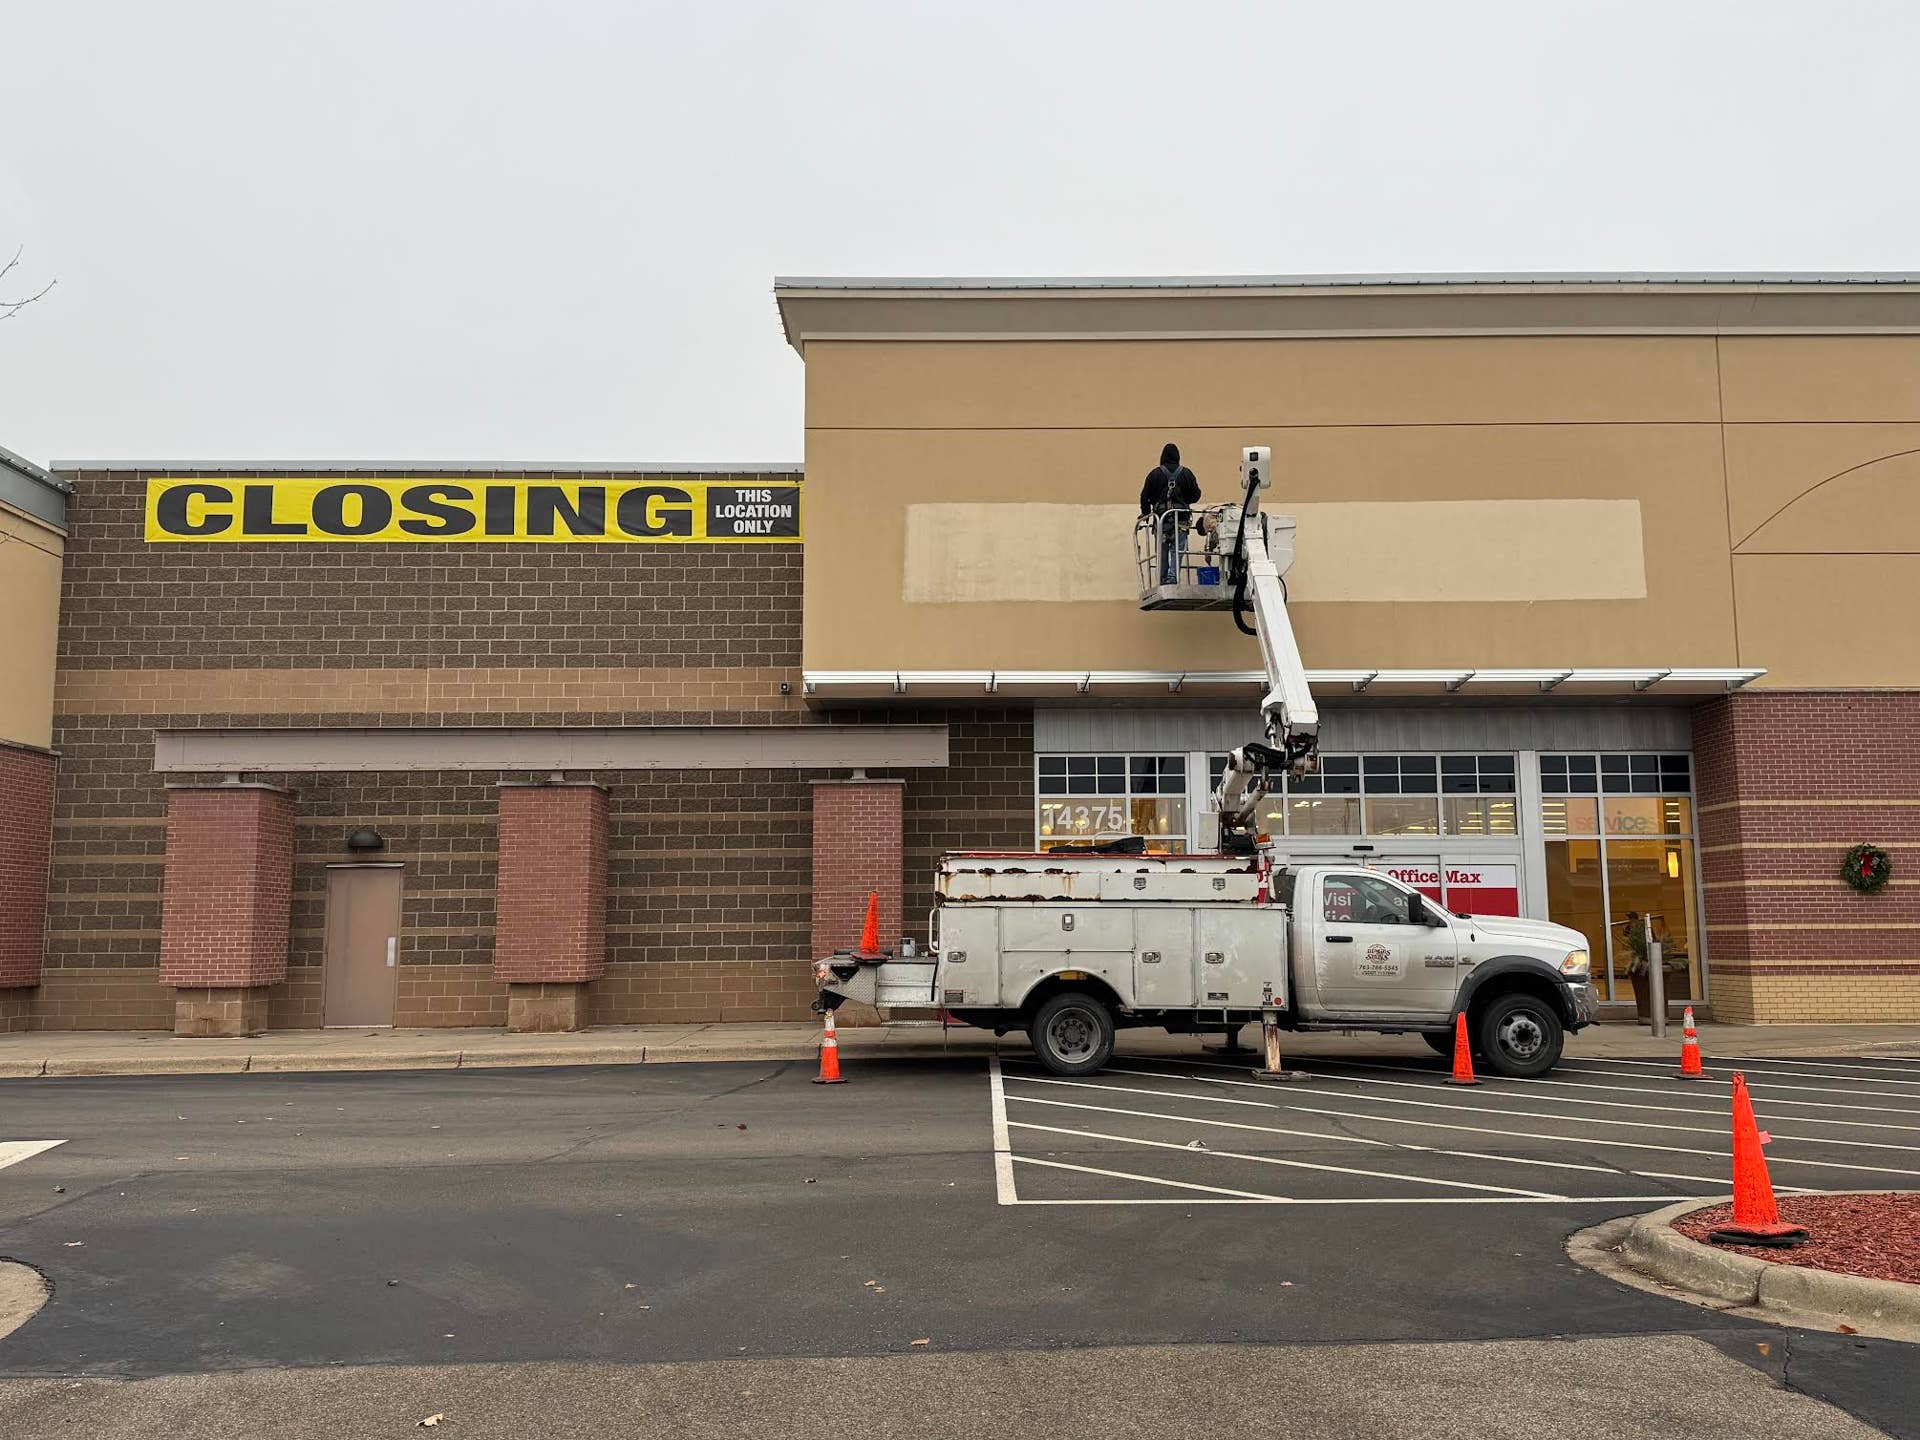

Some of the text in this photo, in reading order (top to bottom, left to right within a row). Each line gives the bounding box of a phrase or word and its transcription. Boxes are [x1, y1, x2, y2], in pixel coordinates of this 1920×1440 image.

[735, 489, 772, 502] THIS
[157, 484, 693, 537] CLOSING
[715, 504, 792, 518] LOCATION
[733, 520, 774, 533] ONLY
[1043, 806, 1123, 831] 14375
[1576, 810, 1657, 832] sevices
[1388, 869, 1439, 883] Office
[1324, 892, 1355, 906] Visi
